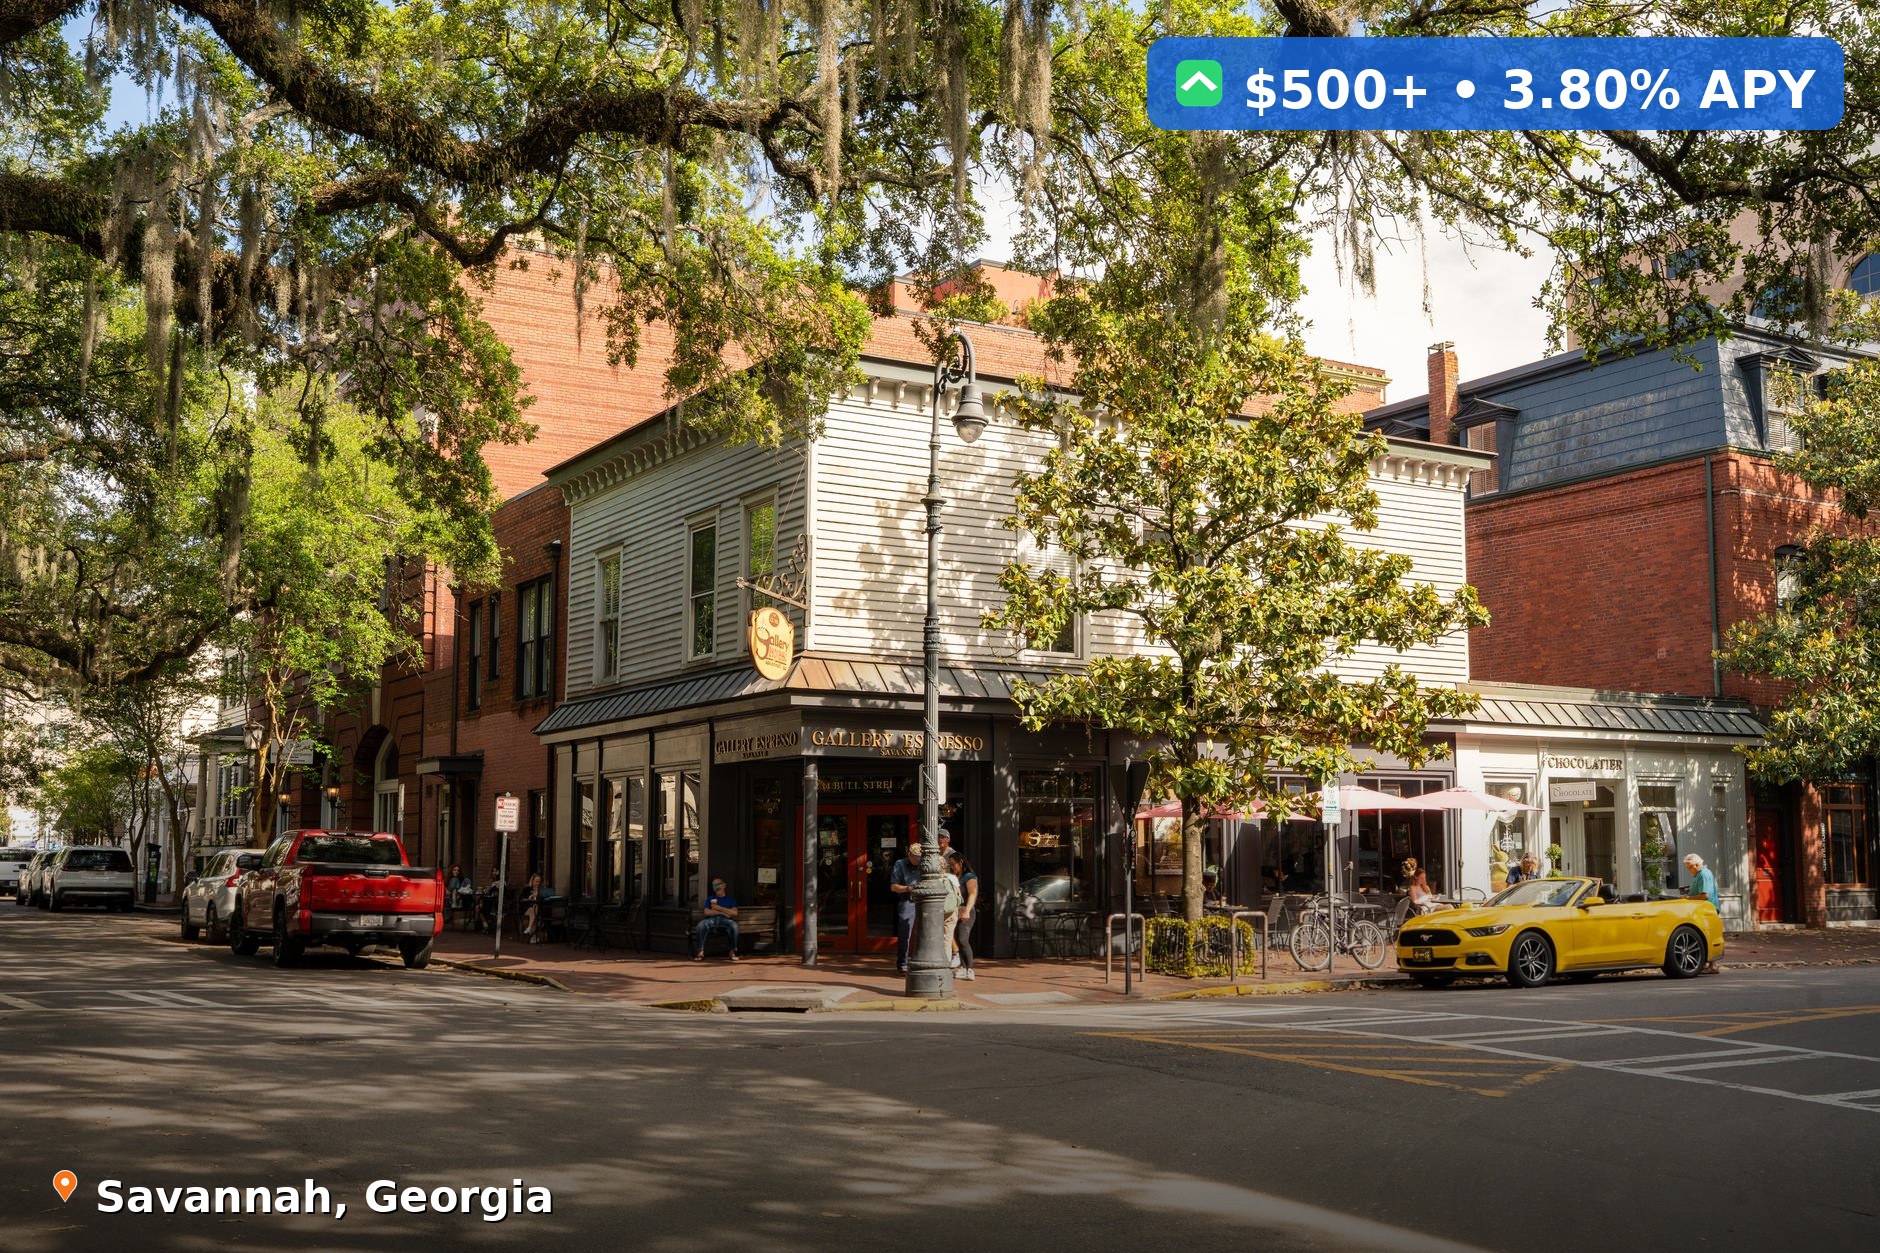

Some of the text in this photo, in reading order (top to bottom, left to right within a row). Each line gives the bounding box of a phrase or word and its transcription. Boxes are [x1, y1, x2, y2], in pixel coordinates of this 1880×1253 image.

[715, 731, 798, 754] GALLERY ESPRESSO
[811, 731, 984, 751] GALLERY ESRESSO
[879, 748, 922, 757] SAVANNAH
[1547, 755, 1623, 771] CHOCOLATIER
[833, 780, 861, 791] BULL
[1552, 786, 1592, 798] CHOCOLATE
[340, 888, 411, 899] TUNDRA
